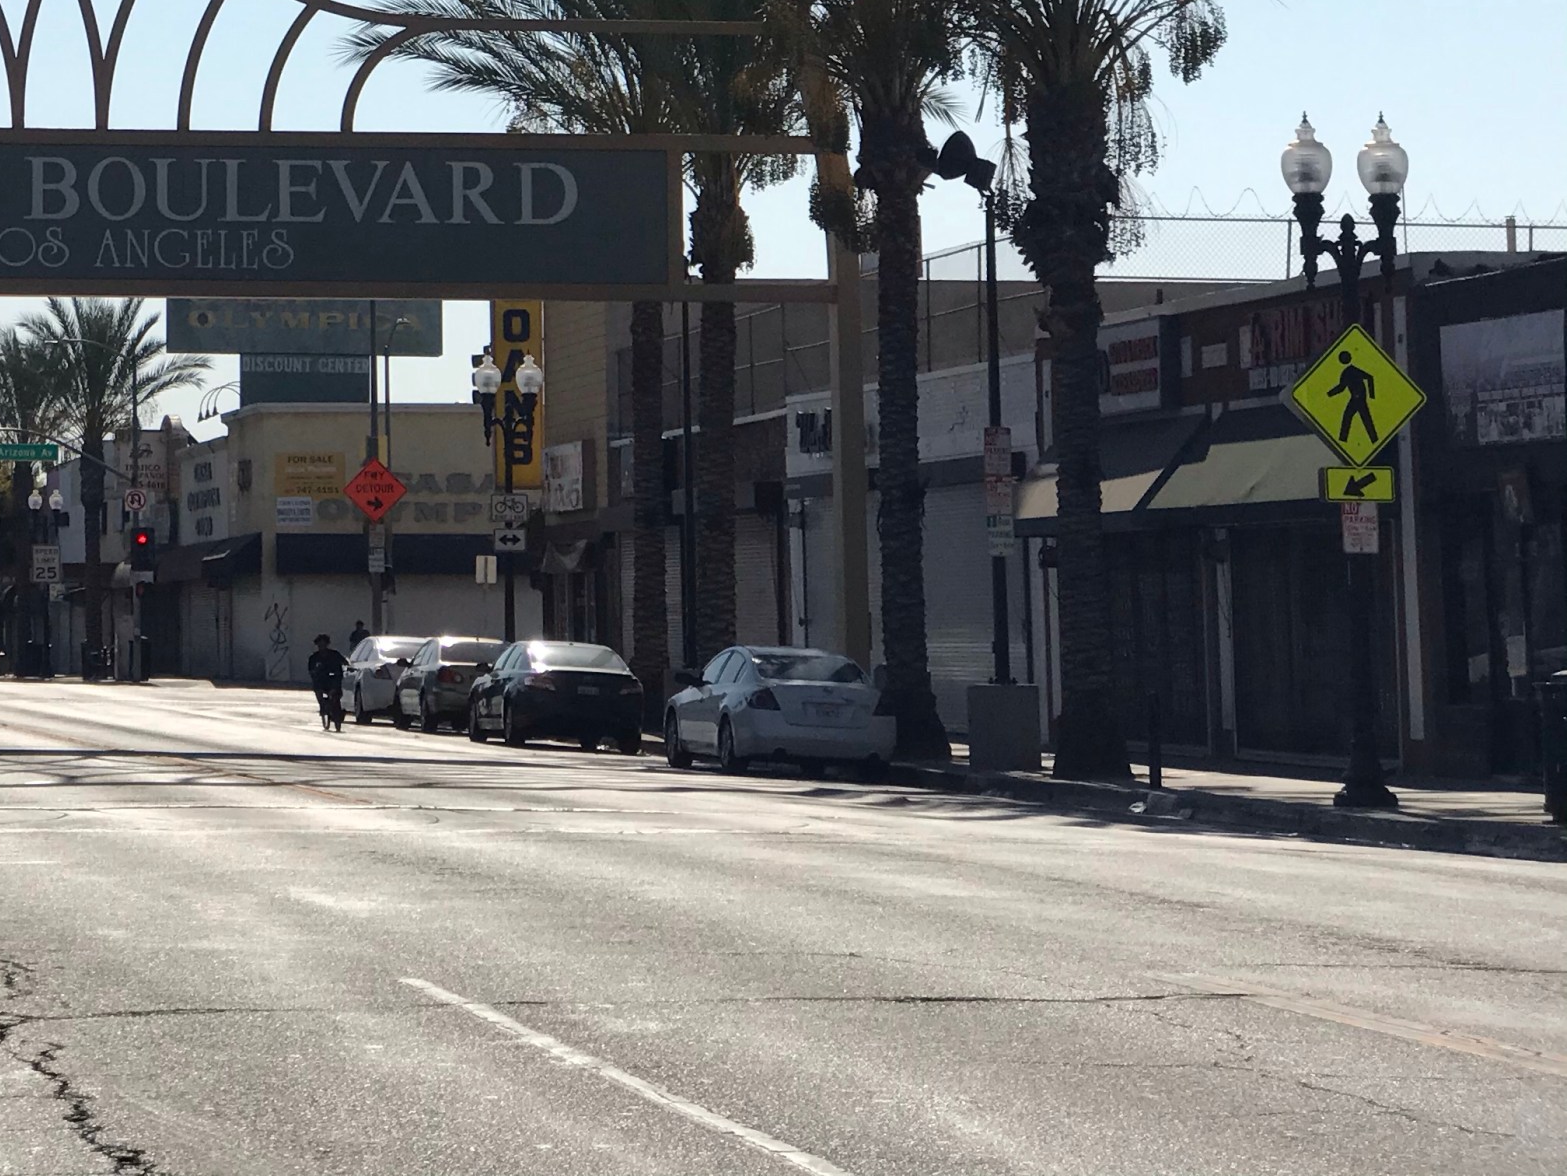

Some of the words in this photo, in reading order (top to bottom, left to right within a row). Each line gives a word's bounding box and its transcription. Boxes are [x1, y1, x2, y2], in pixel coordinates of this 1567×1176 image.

[24, 155, 579, 225] BOULEVARD
[94, 227, 295, 270] ANGELES
[243, 356, 312, 373] DISCOUNT
[318, 357, 370, 374] CENTER
[501, 309, 532, 465] OANS
[41, 448, 53, 457] Av
[287, 455, 307, 464] FOR
[310, 455, 334, 465] SALE
[355, 484, 395, 494] DETOUR
[35, 566, 57, 579] 25
